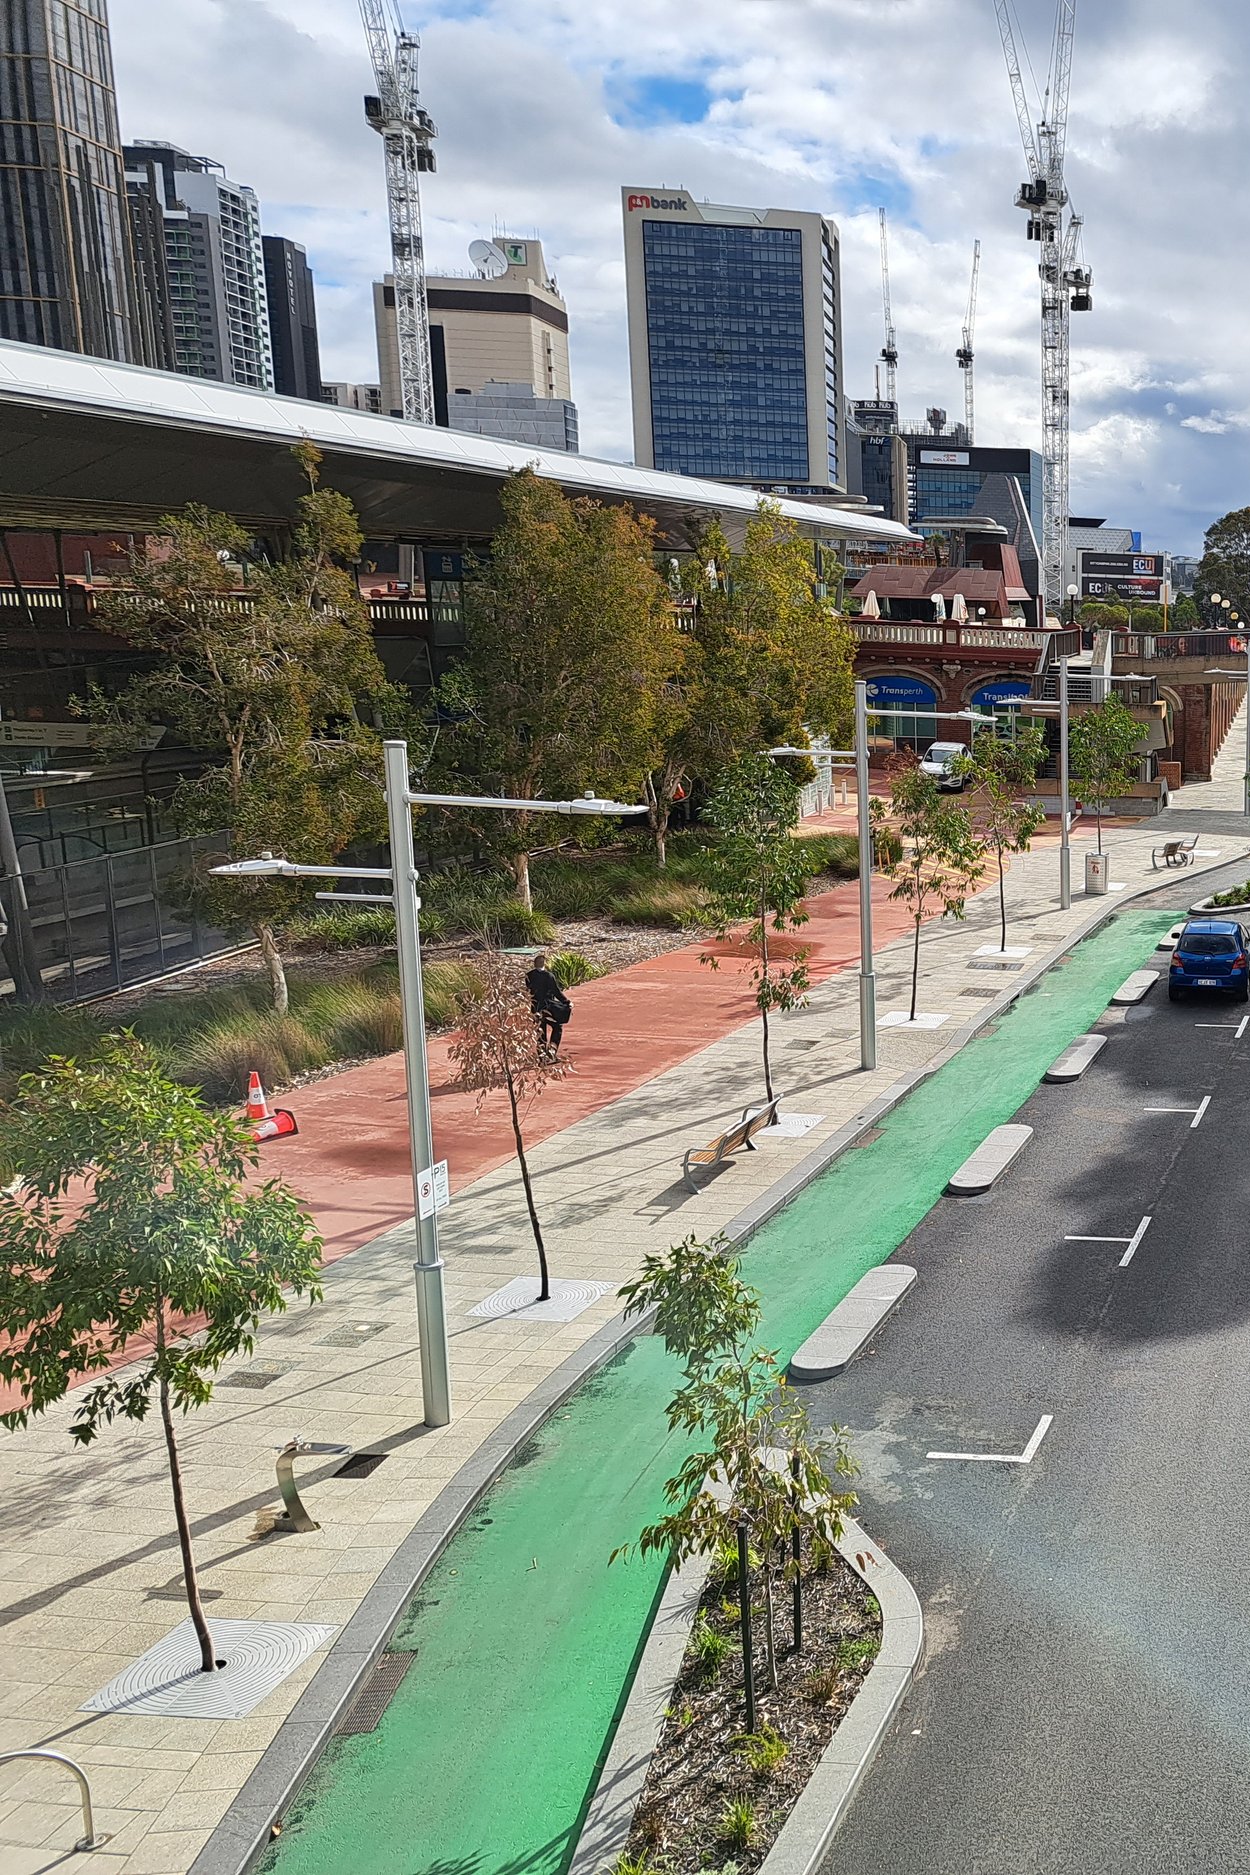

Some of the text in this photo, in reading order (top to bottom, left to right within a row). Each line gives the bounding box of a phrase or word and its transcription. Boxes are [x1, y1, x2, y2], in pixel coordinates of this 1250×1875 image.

[651, 196, 687, 210] bank
[286, 251, 296, 315] NOVOTEL
[869, 436, 885, 445] hbf
[1133, 559, 1152, 570] ECU
[881, 685, 923, 696] Transperth
